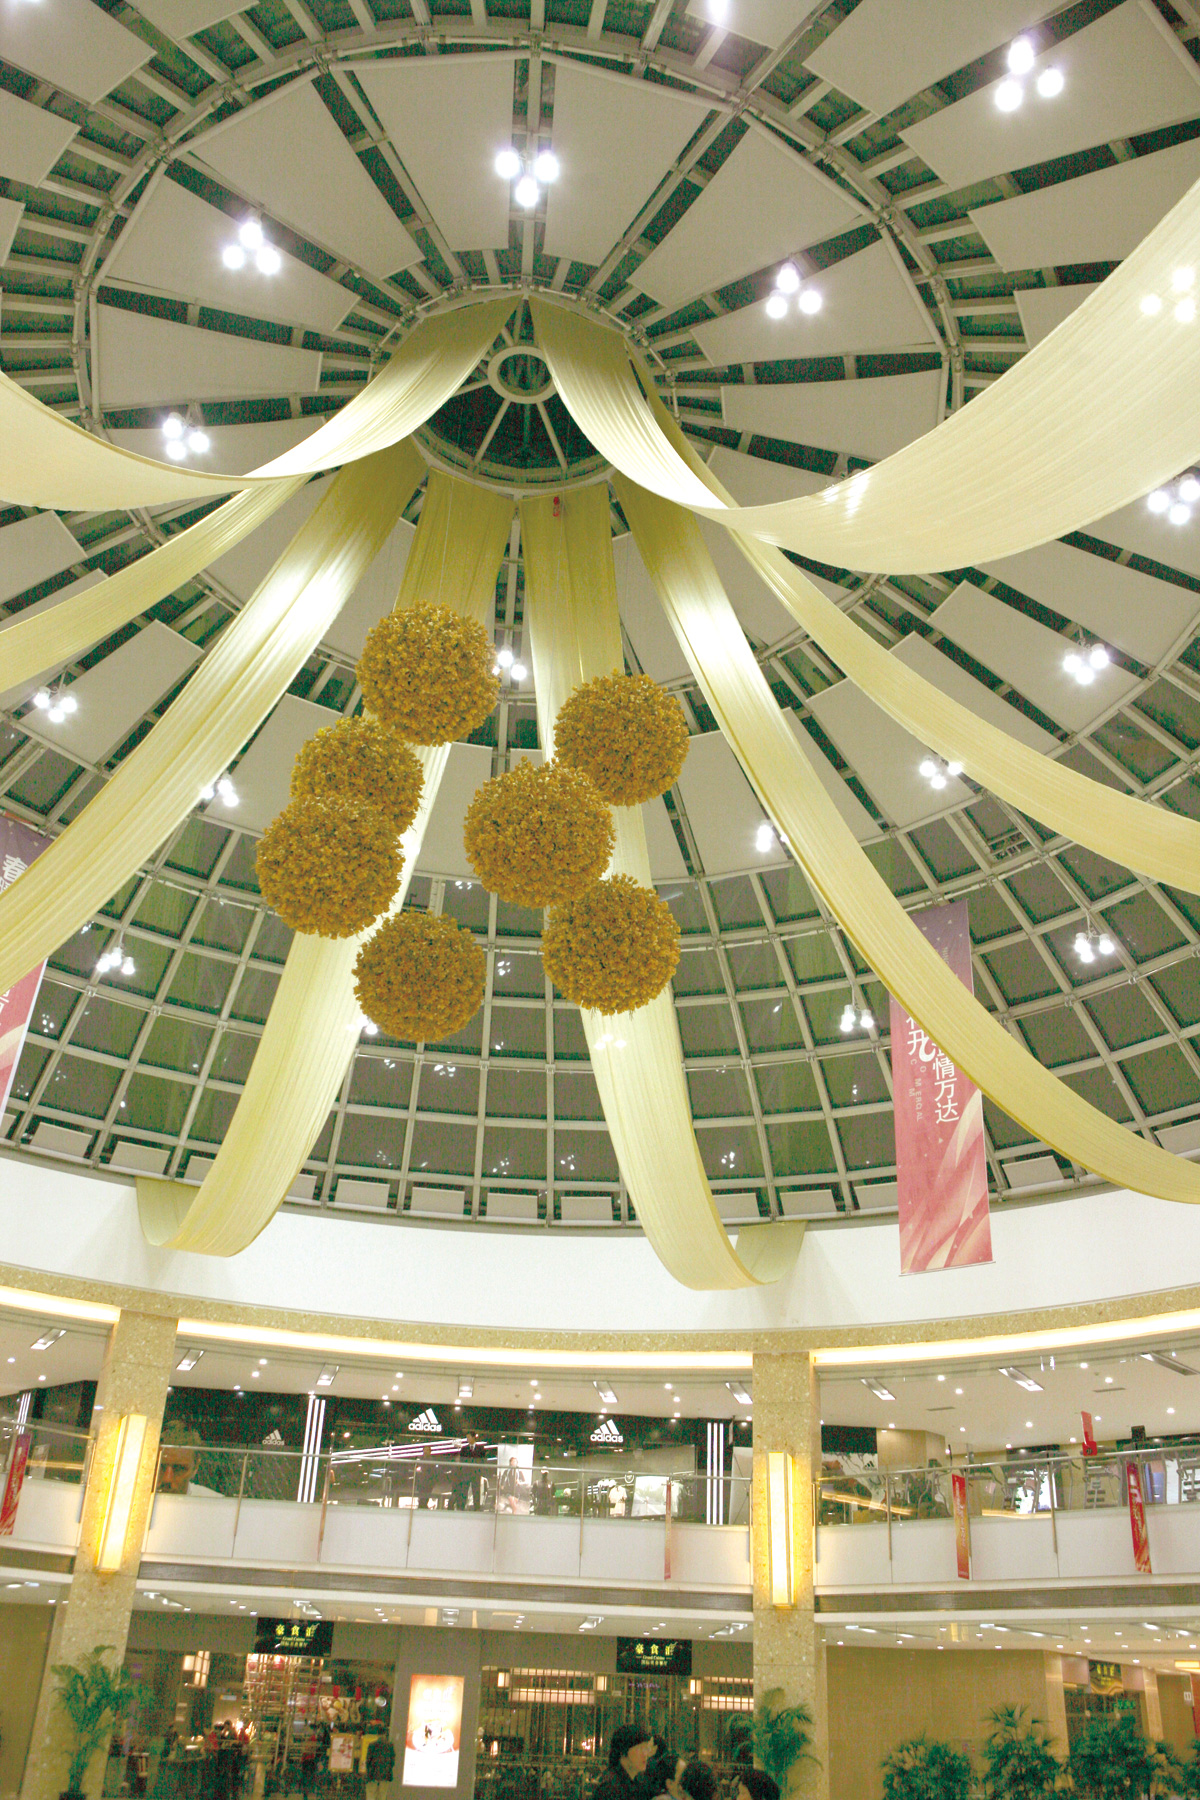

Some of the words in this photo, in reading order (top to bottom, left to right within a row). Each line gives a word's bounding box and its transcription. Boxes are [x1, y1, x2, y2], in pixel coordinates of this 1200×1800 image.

[408, 1422, 443, 1432] adidas
[262, 1438, 285, 1446] adidas
[590, 1433, 624, 1443] adidas
